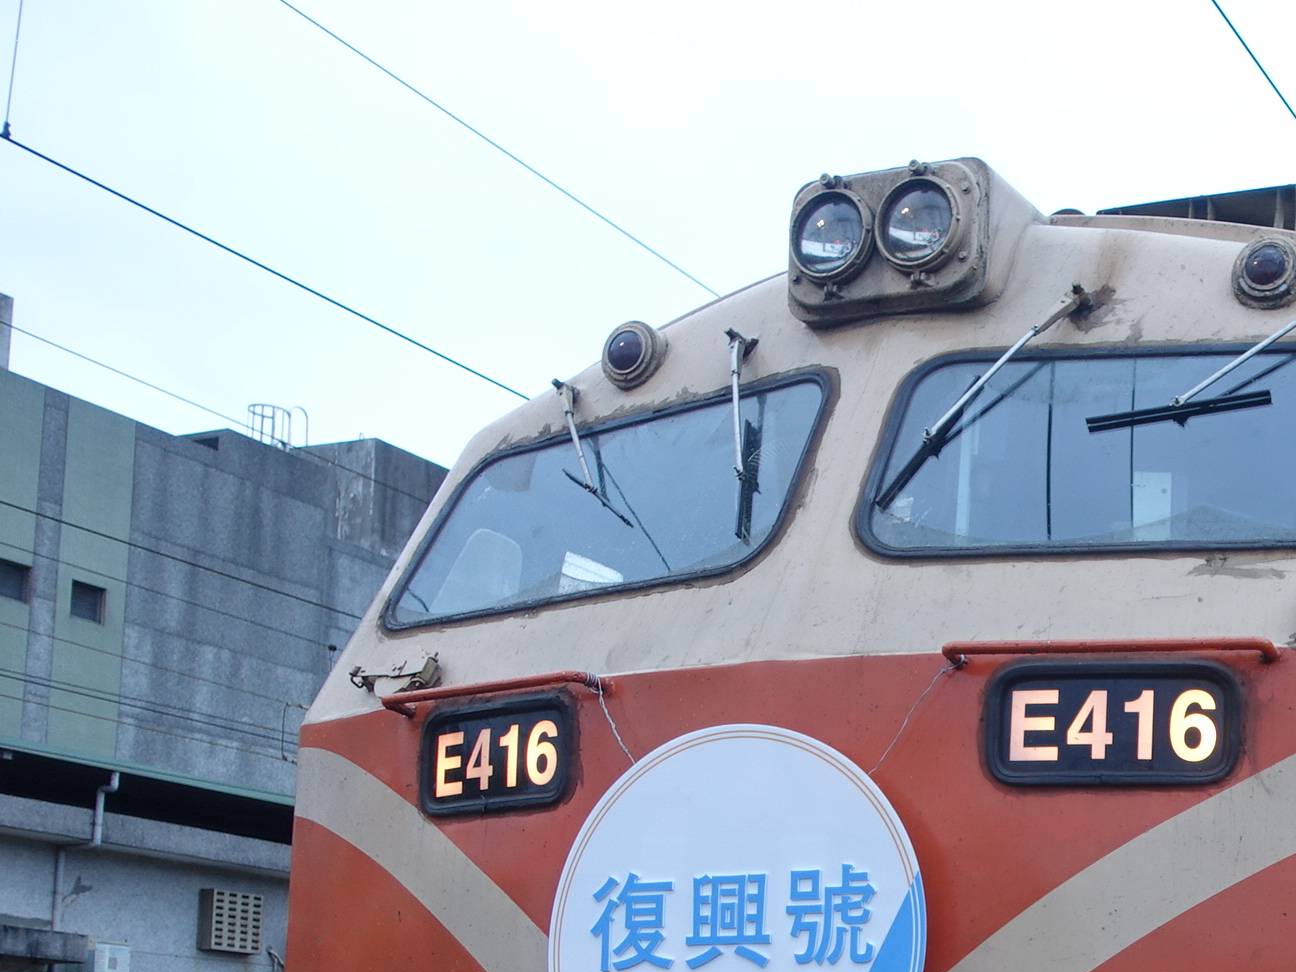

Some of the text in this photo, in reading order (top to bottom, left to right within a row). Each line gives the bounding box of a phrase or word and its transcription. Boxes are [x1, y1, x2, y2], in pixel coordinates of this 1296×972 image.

[435, 718, 559, 799] E416
[1009, 687, 1218, 764] E416
[590, 863, 878, 972] 復興號
